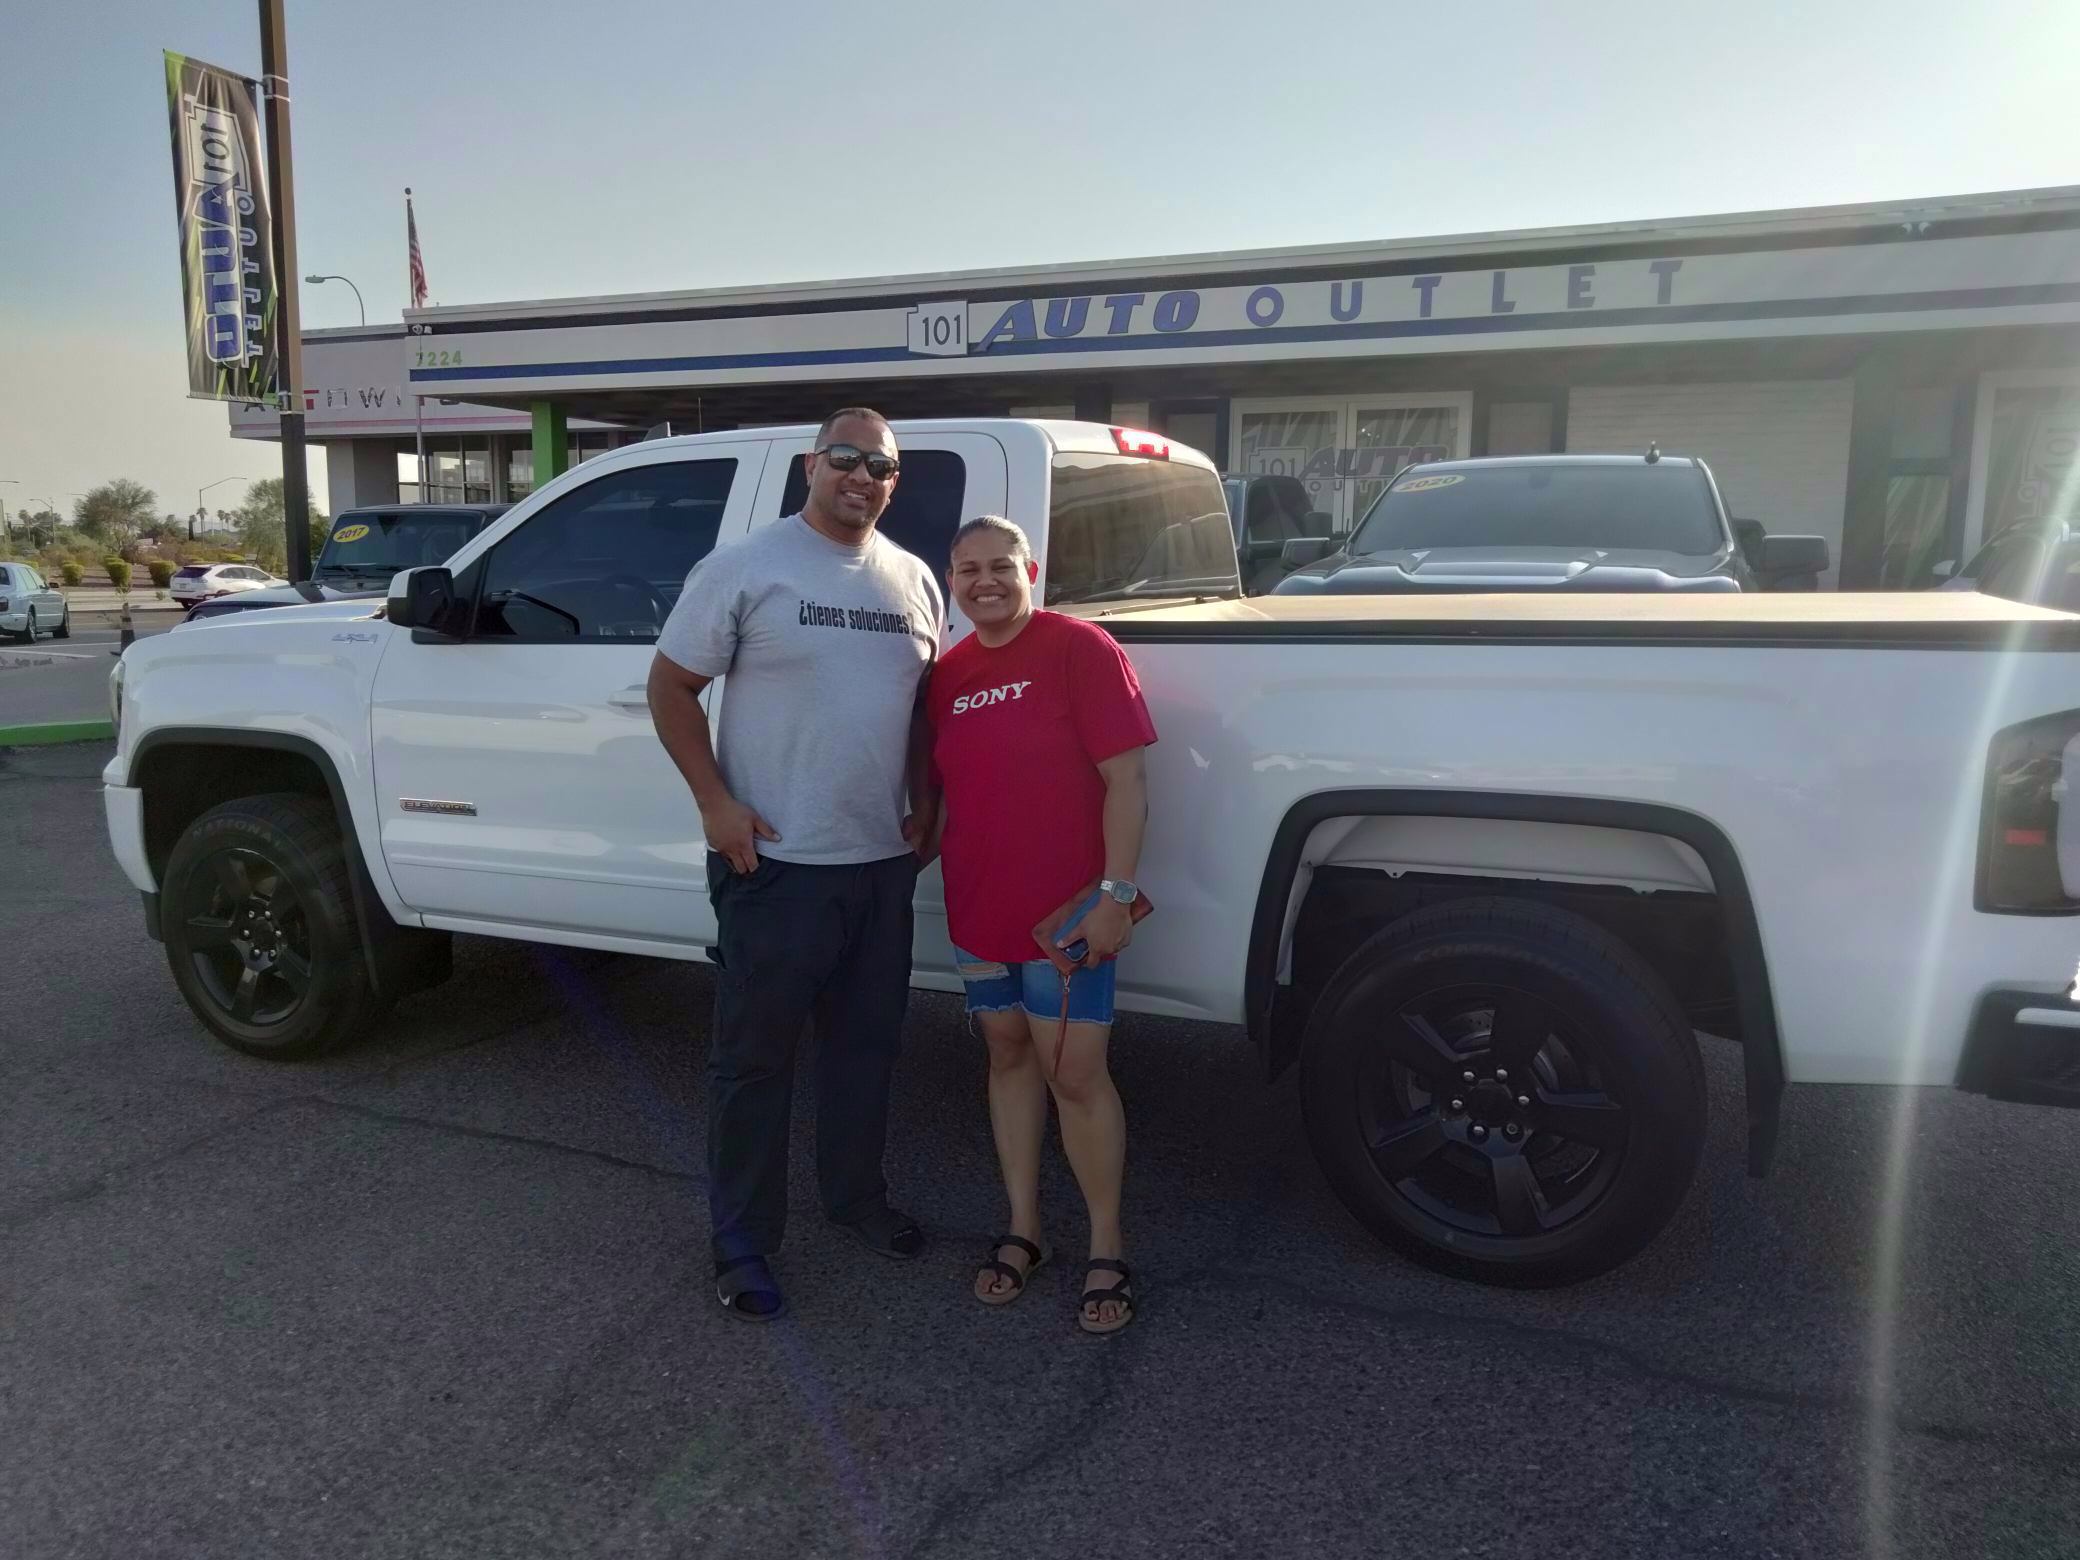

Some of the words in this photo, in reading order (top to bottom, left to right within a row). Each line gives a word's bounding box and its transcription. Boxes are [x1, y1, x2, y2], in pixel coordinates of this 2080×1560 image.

[201, 123, 233, 175] 101
[194, 172, 242, 361] AUTO
[237, 192, 264, 357] OUTLET
[922, 314, 961, 347] 101
[973, 290, 1201, 352] AUTO
[1245, 260, 1684, 328] OUTLET
[415, 350, 463, 368] 7224
[336, 526, 366, 540] 2017
[799, 600, 846, 628] ¿tienes
[952, 681, 1032, 715] SONY
